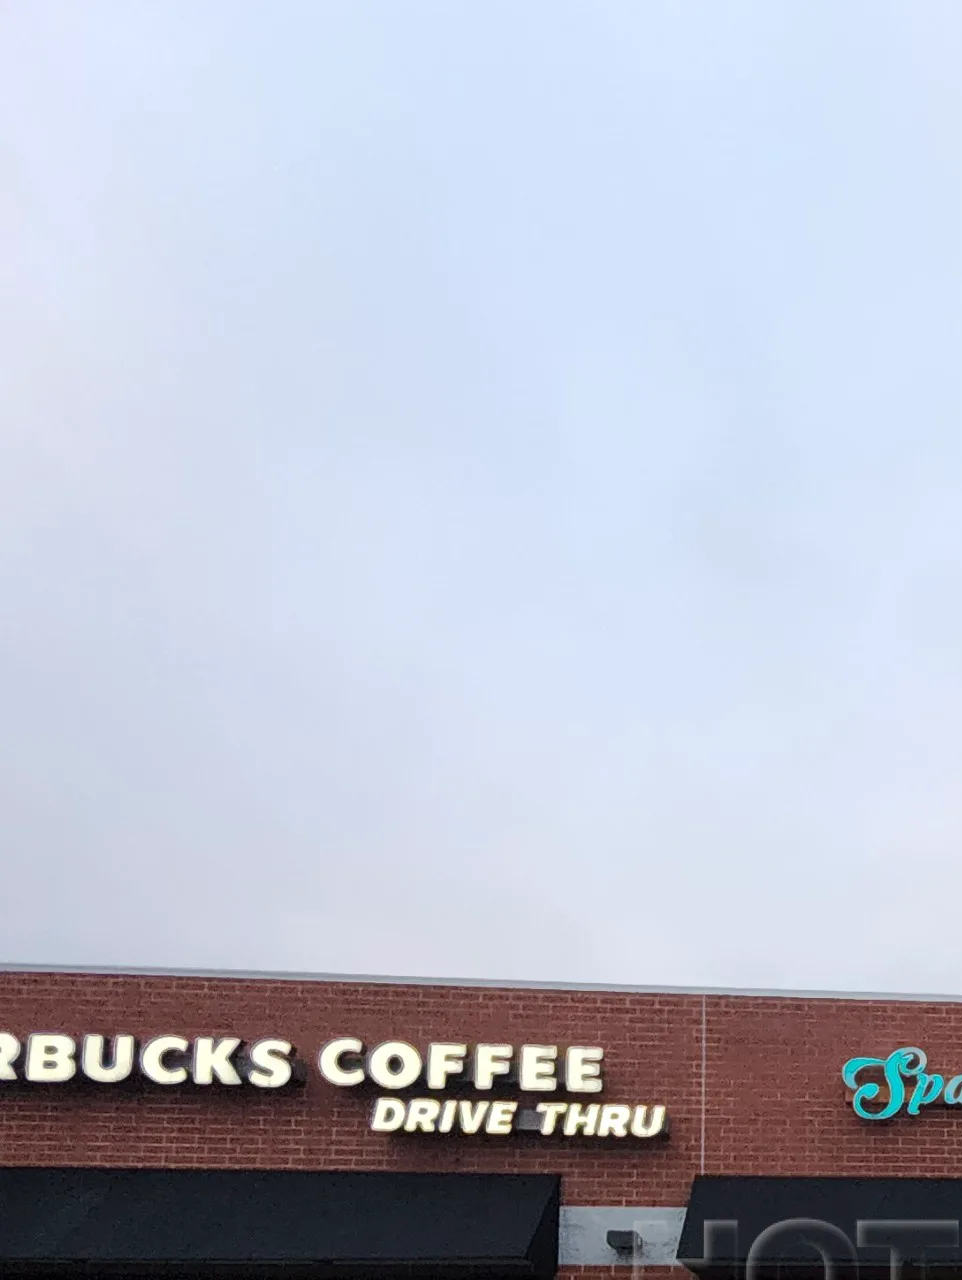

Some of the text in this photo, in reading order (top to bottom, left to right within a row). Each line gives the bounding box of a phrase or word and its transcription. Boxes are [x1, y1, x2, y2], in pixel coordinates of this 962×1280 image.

[317, 1036, 604, 1093] COFFEE
[371, 1097, 666, 1138] DRIVE THRU
